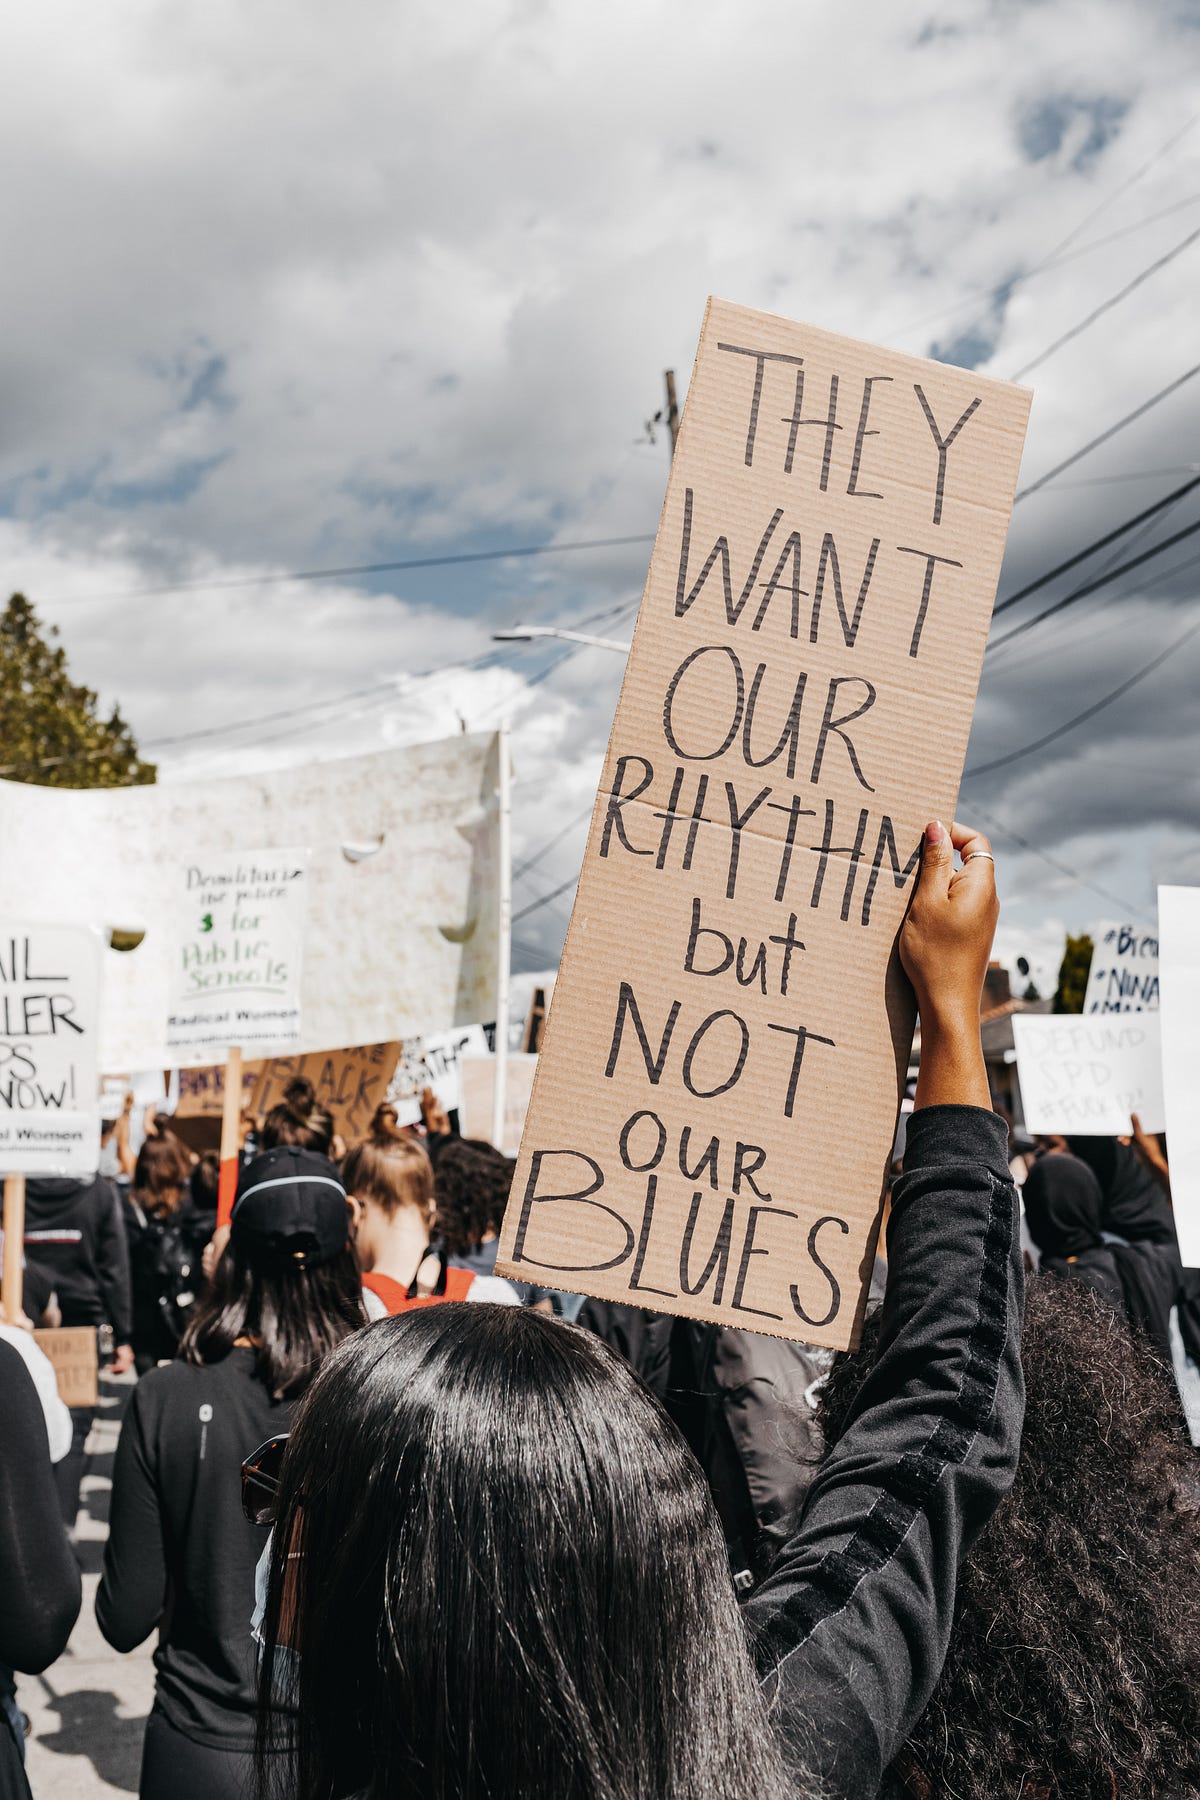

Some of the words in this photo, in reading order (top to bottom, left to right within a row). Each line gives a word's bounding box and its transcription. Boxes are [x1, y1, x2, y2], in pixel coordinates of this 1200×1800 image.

[717, 342, 983, 525] THEY
[674, 488, 964, 658] WANT
[663, 646, 876, 792] OUR
[600, 755, 925, 926] RHYTHM
[182, 939, 269, 970] Public
[190, 959, 288, 988] Schools
[684, 897, 806, 996] but
[167, 1010, 229, 1025] Radical
[236, 1009, 298, 1021] Women
[605, 982, 836, 1118] NOT
[1020, 1026, 1147, 1058] DEFUND
[1039, 1060, 1112, 1094] SPD
[17, 1128, 83, 1141] Women
[619, 1110, 772, 1202] OUR
[512, 1149, 849, 1326] BLUES
